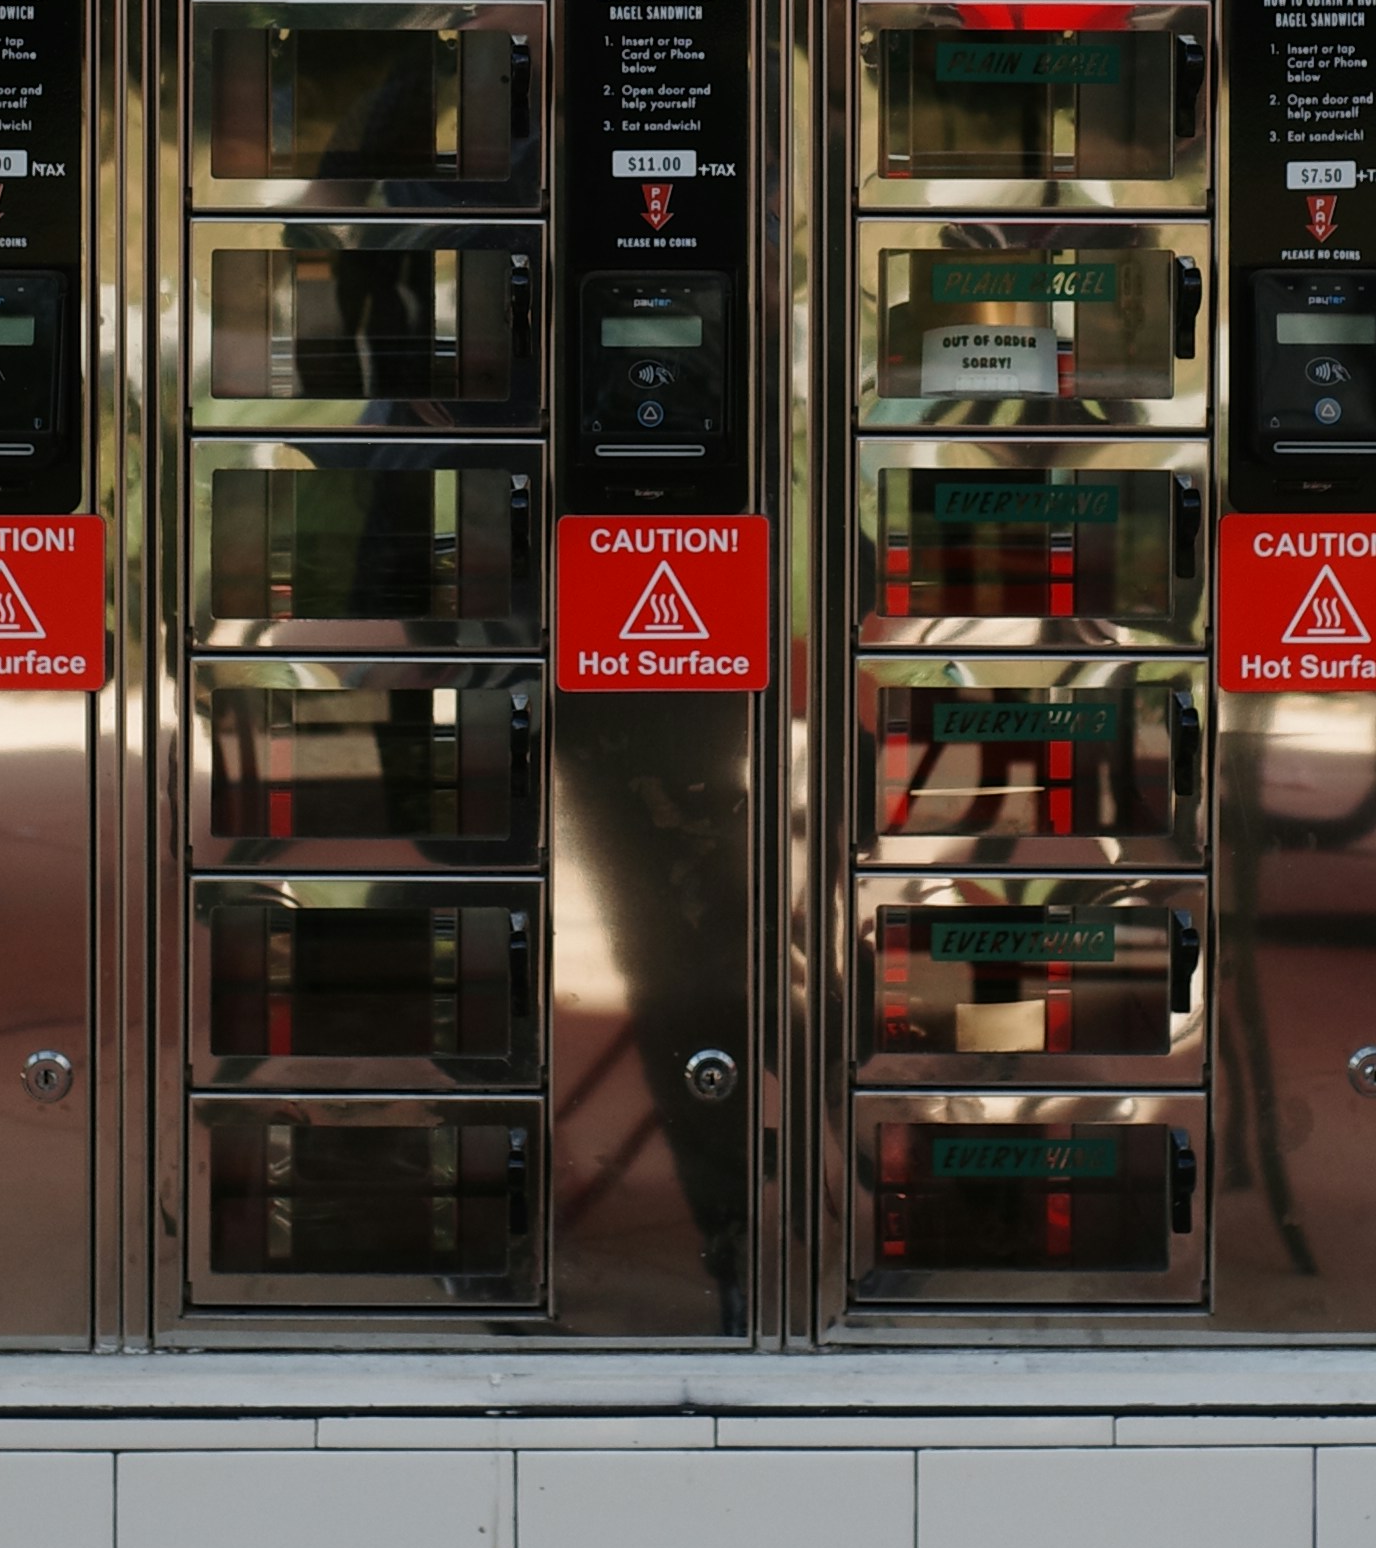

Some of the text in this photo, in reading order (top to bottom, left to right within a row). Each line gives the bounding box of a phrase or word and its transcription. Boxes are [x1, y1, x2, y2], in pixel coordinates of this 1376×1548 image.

[609, 5, 703, 20] BAGEL SANDWICH
[1275, 12, 1365, 28] BAGEL SANDWICH
[605, 36, 613, 46] 1.
[622, 36, 653, 46] Insert
[674, 37, 692, 48] tap
[622, 49, 649, 59] Card
[671, 49, 705, 59] Phone
[622, 62, 656, 73] below
[604, 84, 711, 97] 2. Open door and
[622, 97, 696, 111] help yourself
[604, 120, 700, 131] 3. Eat sandwich!
[628, 156, 681, 172] $11.00
[698, 163, 736, 177] +TAX
[1301, 168, 1342, 185] $7.50
[617, 237, 697, 248] PLEASE NO COINS
[1281, 249, 1361, 261] PLEASE NO COINS
[942, 335, 1037, 349] OUT OF ORDER
[962, 357, 1012, 369] SORRY!
[590, 528, 738, 553] CAUTION!
[579, 650, 750, 675] Hot Surface
[1241, 654, 1292, 679] Hot
